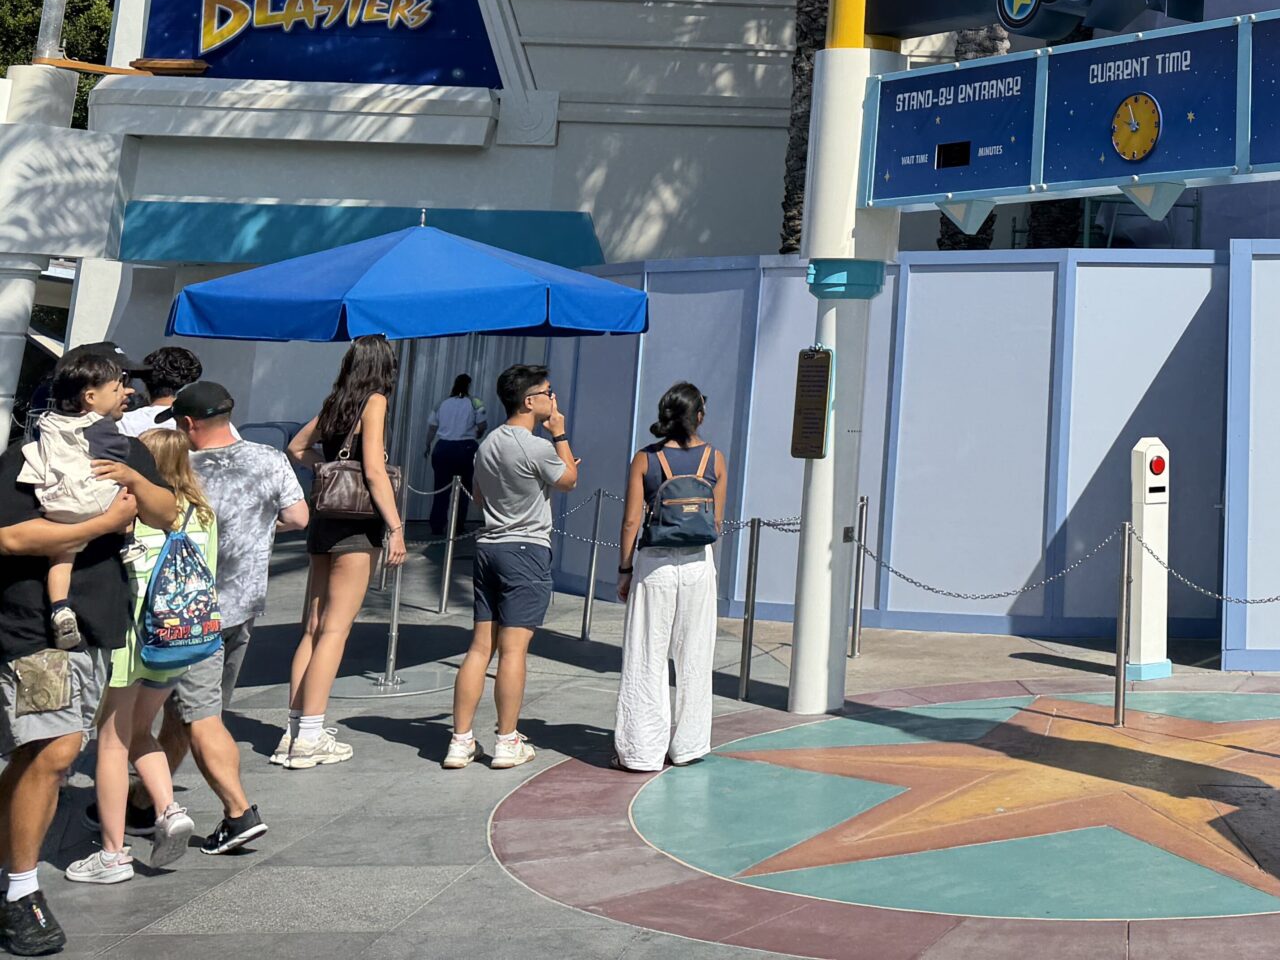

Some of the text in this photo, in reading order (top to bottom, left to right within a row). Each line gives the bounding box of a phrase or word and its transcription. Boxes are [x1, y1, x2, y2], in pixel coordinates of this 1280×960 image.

[896, 86, 955, 112] STAND-BY
[977, 145, 1003, 157] MINUTES
[901, 153, 929, 166] WAIT TIME
